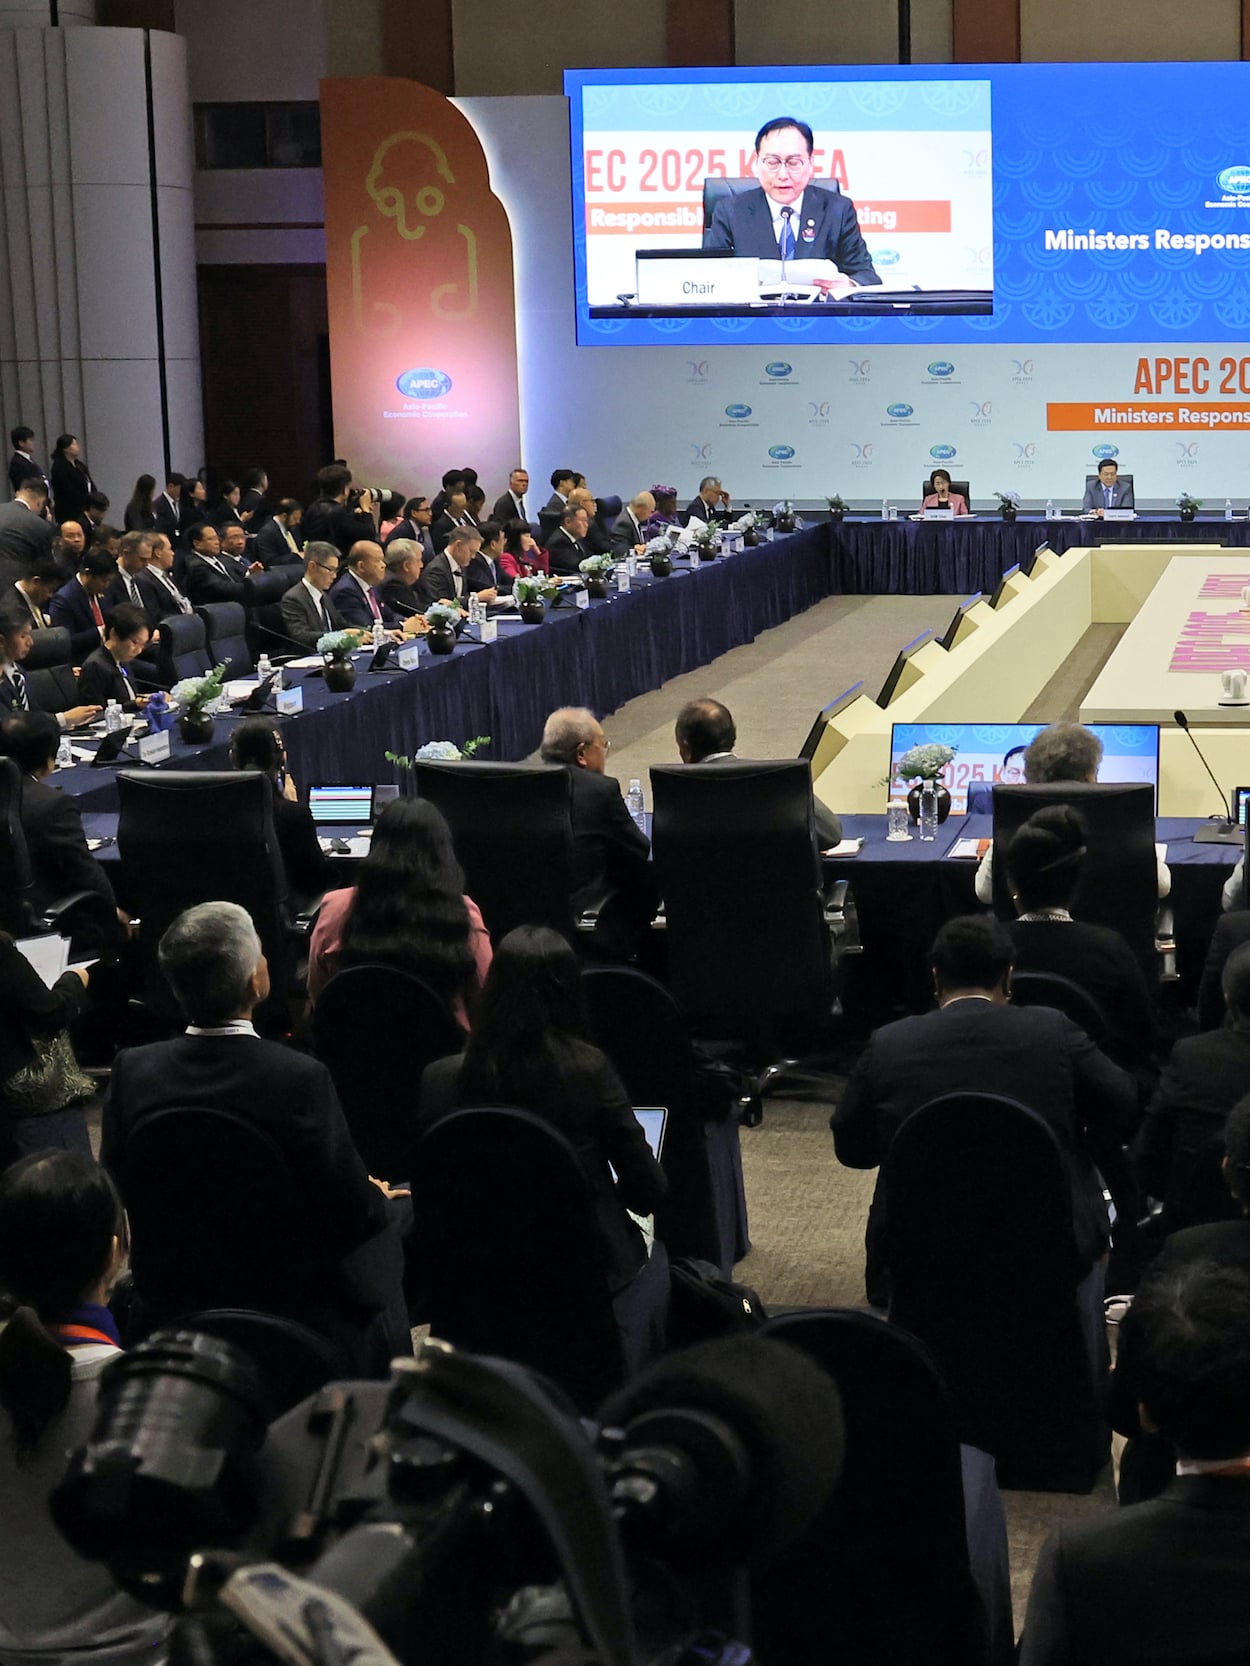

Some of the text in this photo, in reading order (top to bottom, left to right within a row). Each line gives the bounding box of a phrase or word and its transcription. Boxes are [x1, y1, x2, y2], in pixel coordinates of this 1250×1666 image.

[639, 149, 727, 192] 2025
[739, 149, 850, 191] KEA
[591, 207, 704, 232] Responsibl
[1045, 229, 1150, 251] Ministers
[682, 280, 716, 295] Chair
[410, 379, 439, 389] APEC
[1135, 357, 1210, 394] APEC
[1094, 407, 1175, 424] Ministers
[942, 763, 985, 789] 025
